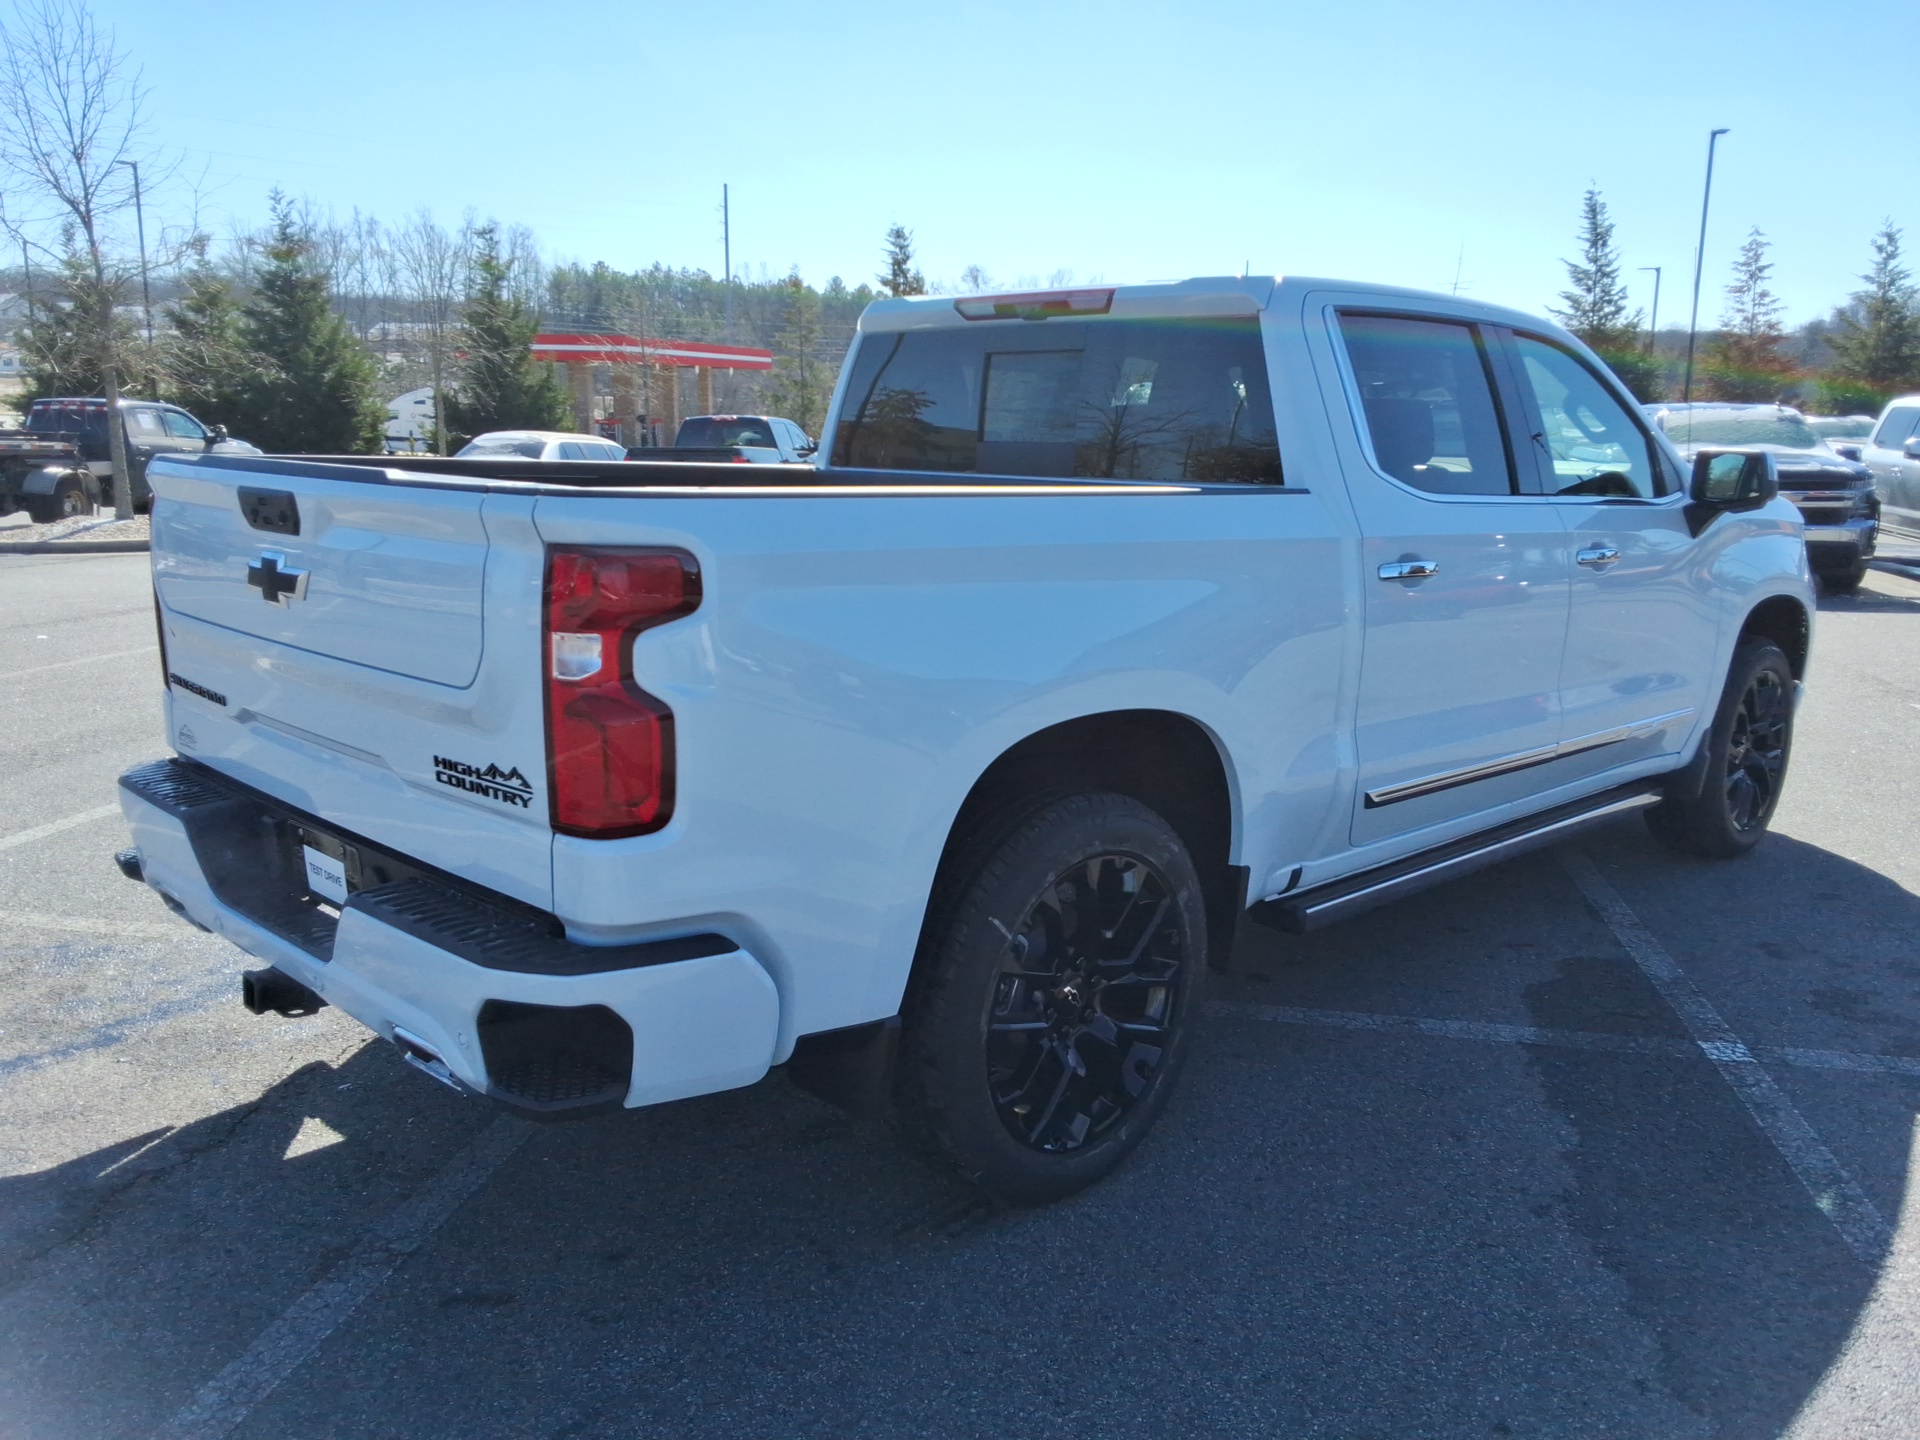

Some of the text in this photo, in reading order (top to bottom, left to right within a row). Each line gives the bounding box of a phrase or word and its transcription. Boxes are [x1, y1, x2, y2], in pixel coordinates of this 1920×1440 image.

[433, 755, 481, 780] HIGH
[435, 770, 533, 808] COUNTRY
[308, 861, 343, 887] TEST DRIVE
